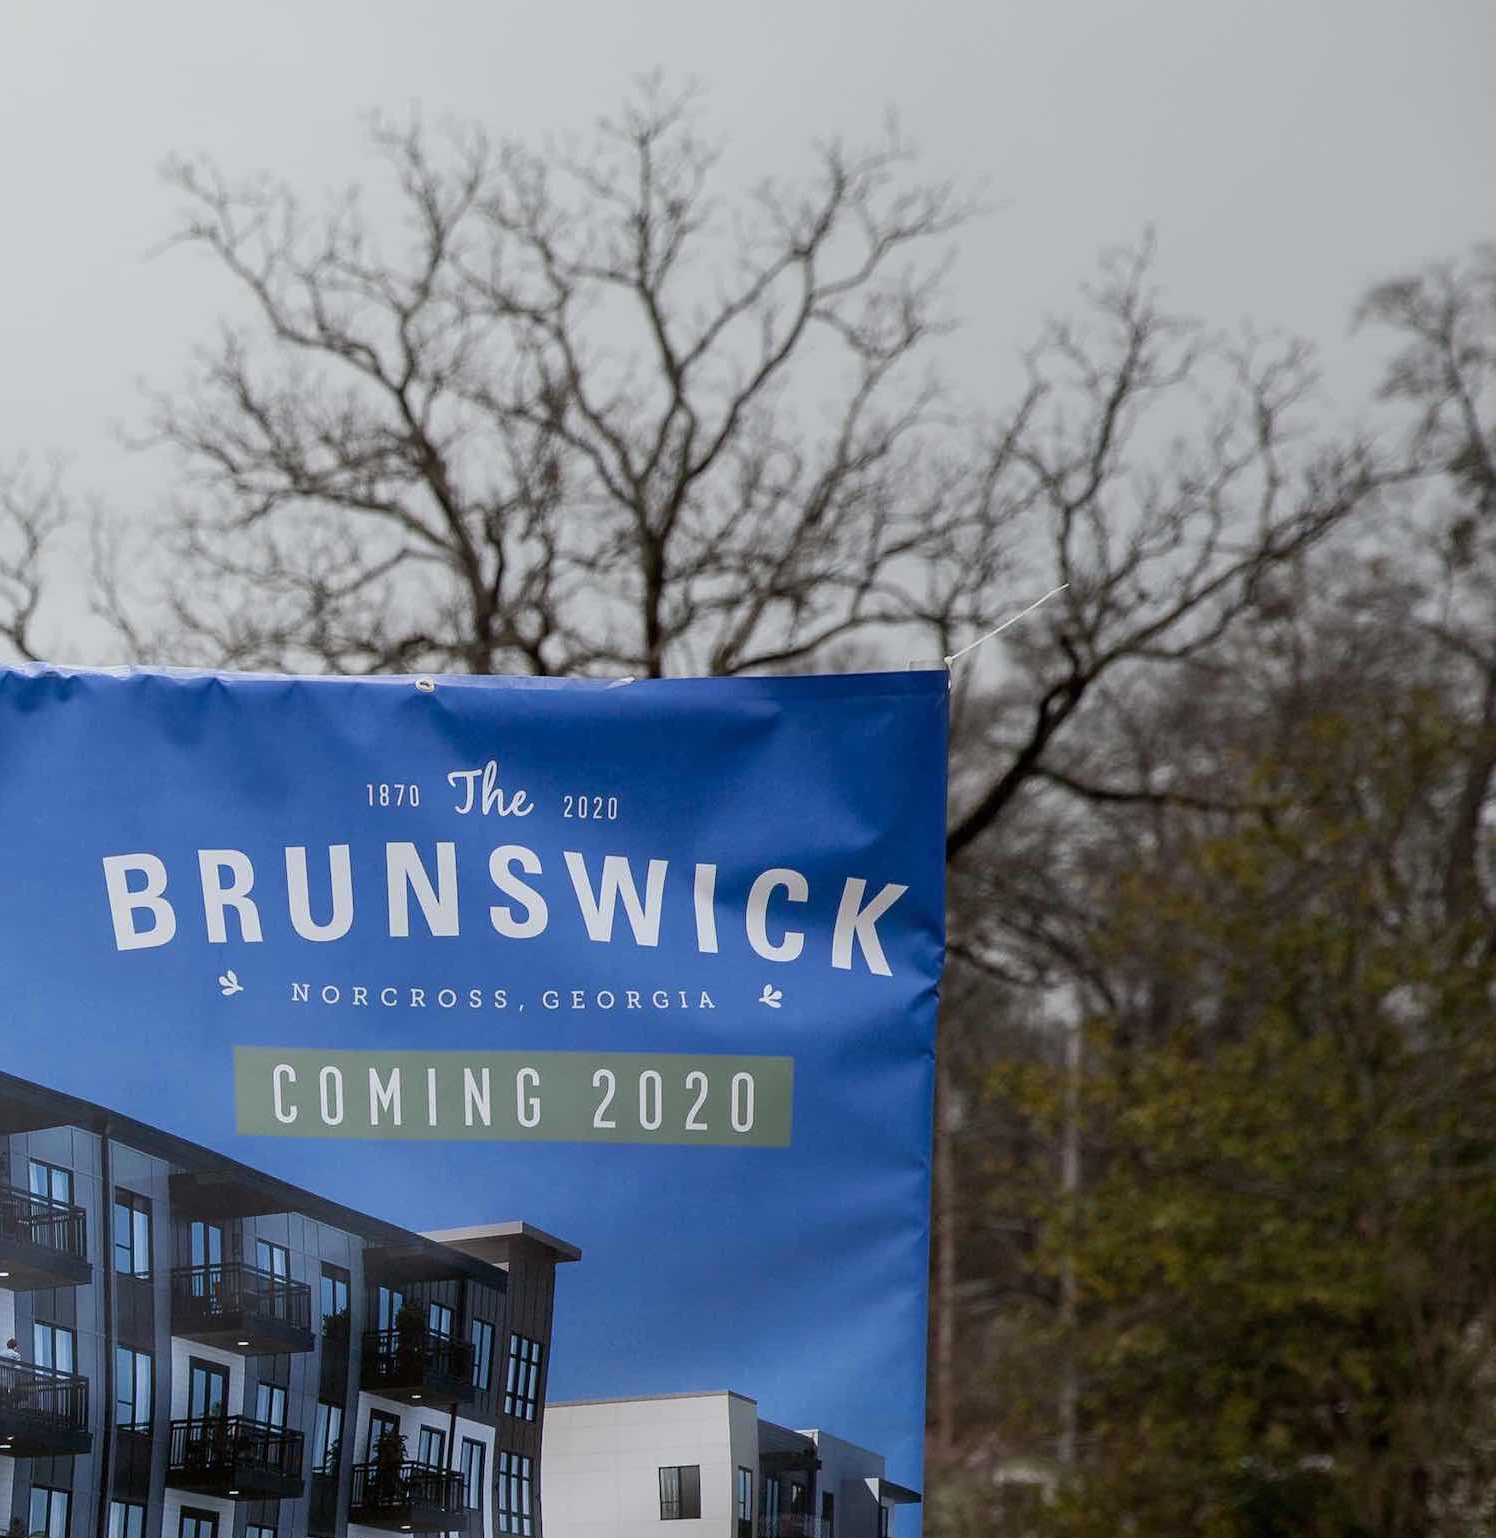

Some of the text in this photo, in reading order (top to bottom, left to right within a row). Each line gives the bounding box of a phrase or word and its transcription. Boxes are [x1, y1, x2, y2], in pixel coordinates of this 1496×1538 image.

[366, 783, 421, 808] 1870
[447, 759, 535, 818] The
[563, 795, 619, 821] 2020
[102, 841, 909, 976] BRUNSWICK
[291, 982, 717, 1012] NORCROSS, GEORGIA
[272, 1063, 756, 1133] COMING 2020
